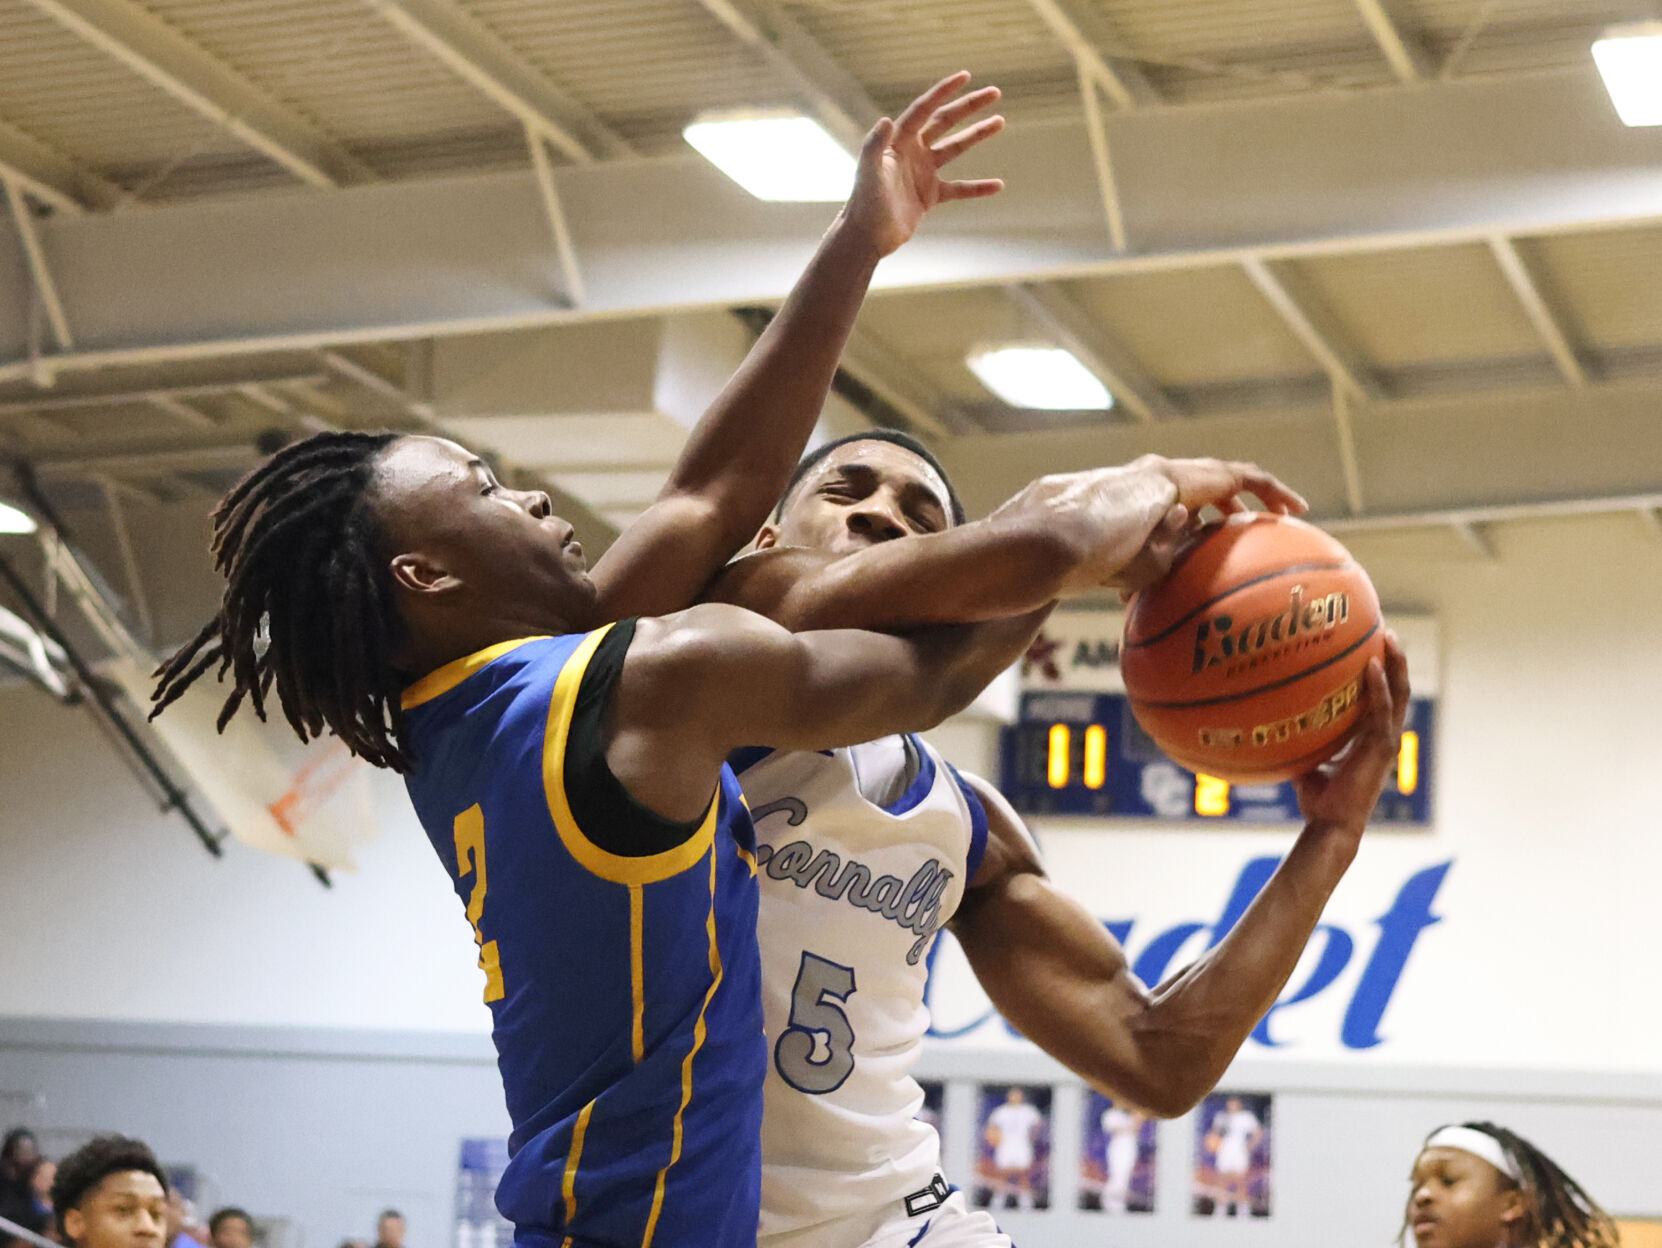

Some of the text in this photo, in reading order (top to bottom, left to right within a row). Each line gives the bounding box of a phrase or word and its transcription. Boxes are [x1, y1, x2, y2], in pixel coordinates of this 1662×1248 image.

[1191, 584, 1350, 675] Baden
[1047, 723, 1107, 790] 11
[774, 949, 858, 1096] 5
